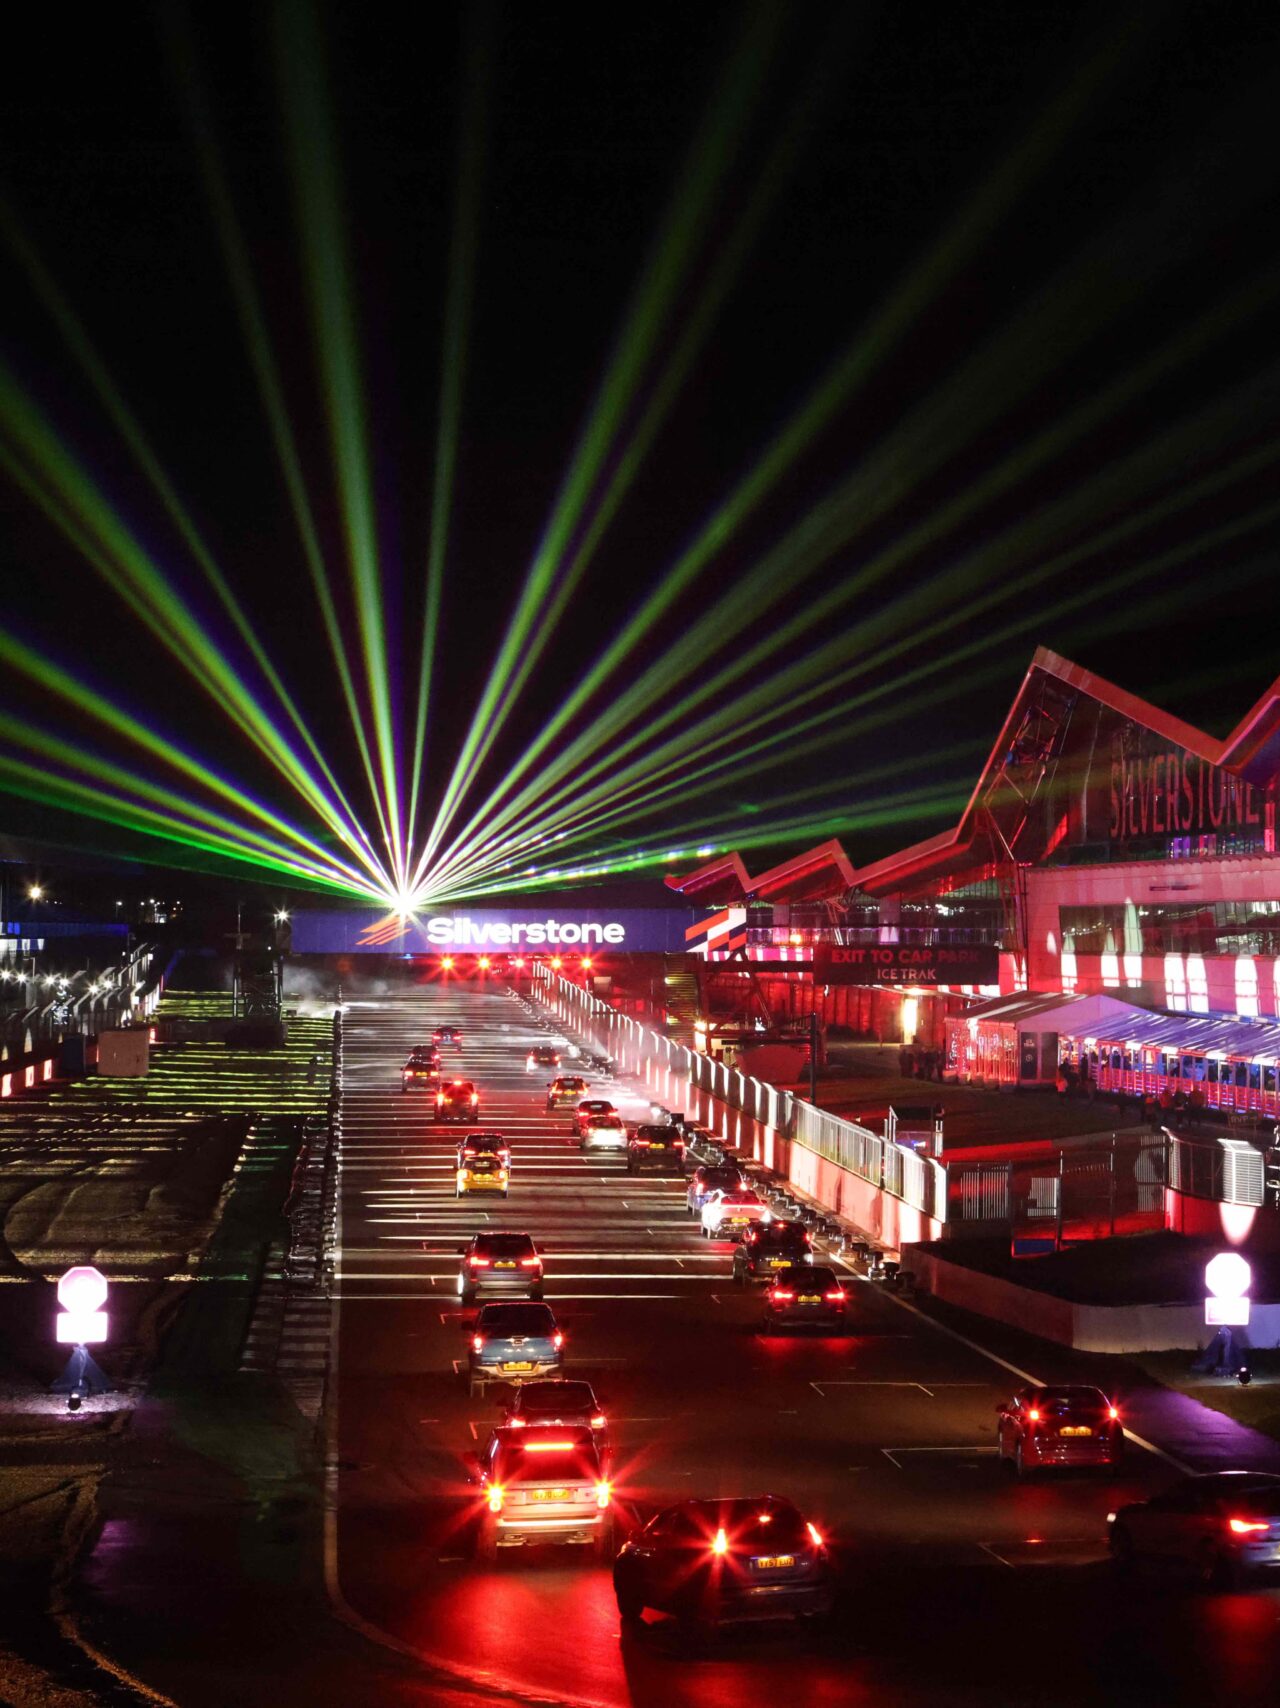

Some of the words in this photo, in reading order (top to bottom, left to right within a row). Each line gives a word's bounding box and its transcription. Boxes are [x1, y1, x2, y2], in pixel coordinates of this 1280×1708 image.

[426, 917, 626, 944] Silverstone
[831, 950, 865, 963] EXIT
[870, 950, 894, 963] TO
[899, 950, 933, 963] CAR
[938, 950, 978, 963] PARK
[877, 968, 898, 980] ICE
[900, 968, 937, 980] TRAK
